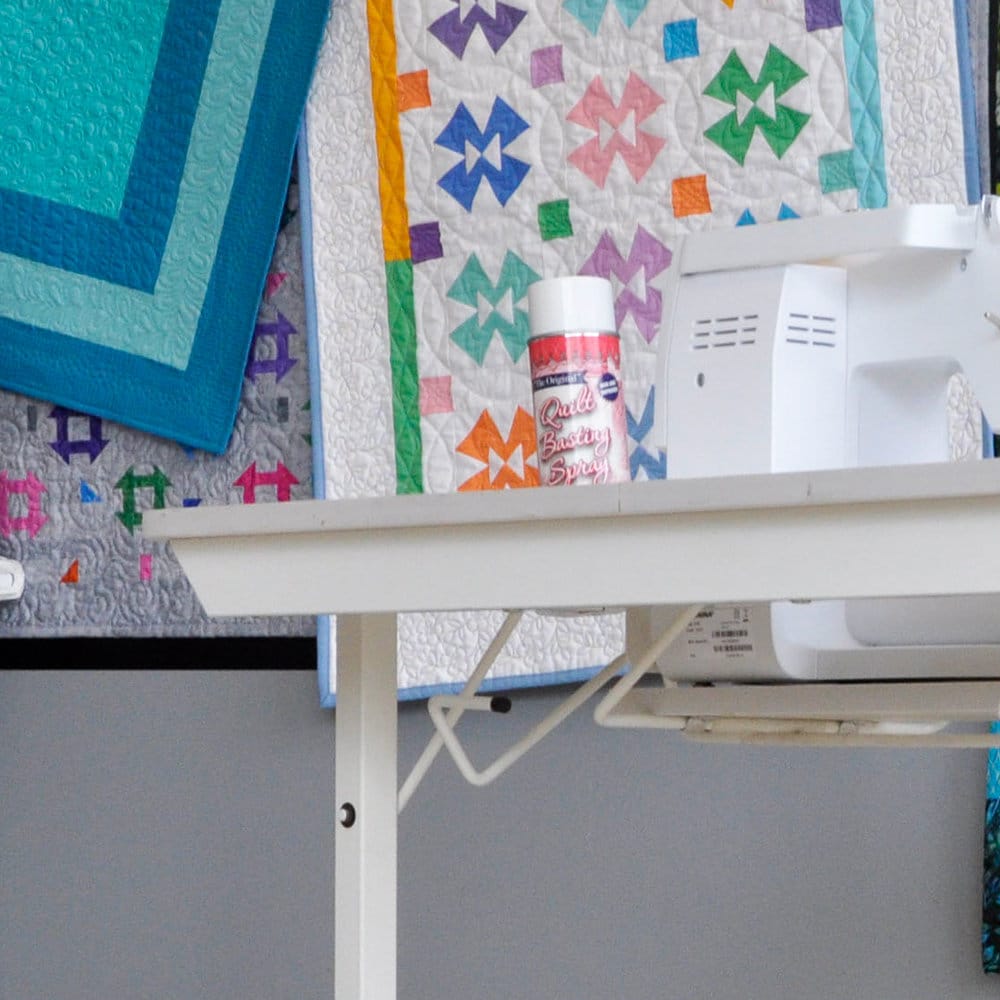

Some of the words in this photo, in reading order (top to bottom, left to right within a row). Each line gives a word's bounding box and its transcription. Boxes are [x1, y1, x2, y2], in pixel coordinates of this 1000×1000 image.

[540, 385, 596, 430] Quilt
[541, 427, 611, 463] Basting
[548, 456, 609, 485] Spray
